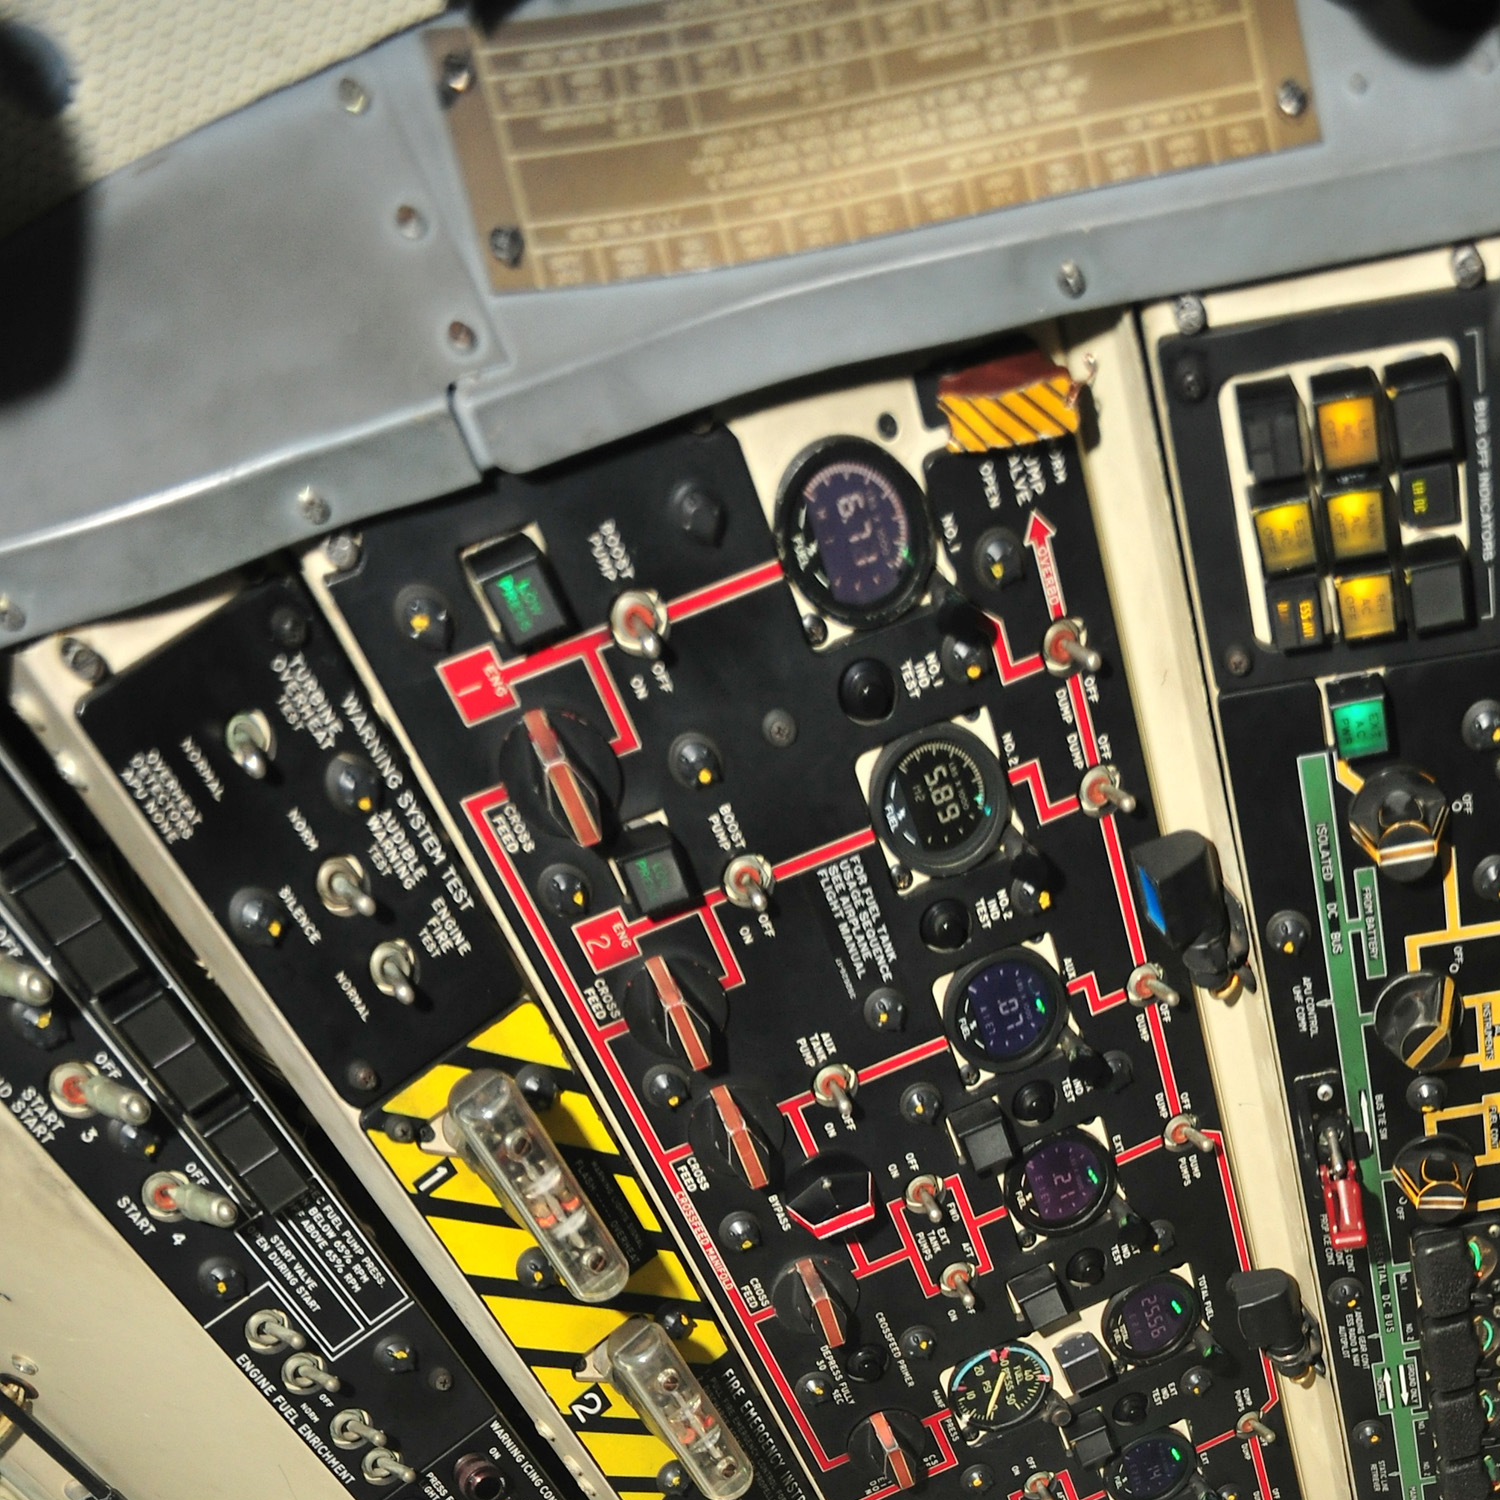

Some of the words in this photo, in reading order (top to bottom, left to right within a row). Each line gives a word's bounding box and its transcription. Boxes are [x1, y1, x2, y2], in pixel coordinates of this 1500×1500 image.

[1473, 400, 1490, 434] BUS
[1476, 437, 1490, 473] OFF
[978, 460, 1001, 509] OPEN
[1478, 473, 1495, 562] INDICATORS
[1036, 546, 1060, 607] OVERBD
[289, 651, 344, 735] TURBINE
[482, 663, 508, 698] ENG
[629, 674, 649, 700] ON
[650, 659, 673, 693] OFF
[900, 659, 921, 699] TEST
[1083, 676, 1100, 704] OFF
[277, 694, 305, 732] TEST
[1055, 687, 1073, 725] DUMP
[180, 735, 224, 801] NORMAL
[1066, 733, 1085, 771] DUMP
[1097, 733, 1113, 762] OFF
[340, 690, 403, 791] WARNING
[397, 792, 448, 867] SYSTEM
[442, 867, 475, 913] TEST
[287, 806, 319, 852] NORM
[378, 810, 428, 884] AUDIBLE
[493, 813, 519, 856] FEED
[501, 801, 537, 855] CROSS
[708, 811, 732, 852] PUMP
[717, 801, 747, 850] BOOST
[367, 813, 417, 891] WARNING
[367, 844, 393, 877] TEST
[1315, 822, 1334, 882] ISOLATED
[277, 884, 322, 945] SILENCE
[828, 864, 846, 893] SEE
[840, 895, 873, 962] AIRPLANE
[840, 860, 865, 910] USAGE
[859, 909, 893, 984] SEQUENCE
[850, 854, 868, 886] FOR
[862, 885, 881, 924] FUEL
[877, 922, 897, 963] TANK
[1326, 902, 1339, 919] DC
[1362, 885, 1374, 916] FROM
[417, 928, 441, 959] TEST
[427, 914, 455, 956] FIRE
[431, 895, 472, 957] ENGINE
[817, 868, 845, 920] FLIGHT
[838, 921, 866, 980] MANUAL
[1330, 932, 1344, 954] BUS
[1365, 917, 1378, 960] BATTERY
[335, 970, 371, 1023] NORMAL
[1483, 1001, 1495, 1060] INSTRUMENTS
[95, 1050, 122, 1081] OFF
[11, 1100, 56, 1144] START
[21, 1085, 65, 1131] START
[80, 1128, 99, 1143] 3
[418, 1166, 449, 1192] 1
[116, 1195, 157, 1237] START
[768, 1194, 792, 1232] BYPASS
[172, 1232, 187, 1246] 4
[301, 1219, 329, 1250] ABOVE
[325, 1249, 343, 1274] 65%
[343, 1273, 362, 1293] RPM
[308, 1206, 337, 1239] BELOW
[333, 1239, 352, 1265] 65%
[352, 1264, 370, 1284] RPM
[323, 1204, 344, 1231] FUEL
[342, 1230, 365, 1257] PUMP
[361, 1256, 387, 1288] PRESS.
[675, 1190, 711, 1258] CROSSFEED
[706, 1241, 735, 1291] MANIFOLD
[268, 1251, 299, 1286] DURING
[296, 1286, 322, 1313] START
[270, 1234, 297, 1263] START
[293, 1262, 318, 1292] VALVE
[820, 1345, 845, 1387] DEPRESS
[874, 1312, 904, 1362] CROSSFEED
[894, 1355, 915, 1389] PRIMER
[1013, 1365, 1023, 1386] FUEL
[235, 1353, 277, 1397] ENGINE
[272, 1395, 301, 1427] FUEL
[296, 1421, 356, 1486] ENRICHMENT
[573, 1392, 603, 1425] 2
[722, 1367, 746, 1400] FIRE
[741, 1400, 786, 1471] EMERGENCY
[1006, 1393, 1016, 1405] 50
[489, 1418, 523, 1462] WARNING
[520, 1458, 543, 1489] ICING
[425, 1471, 449, 1499] PRESS
